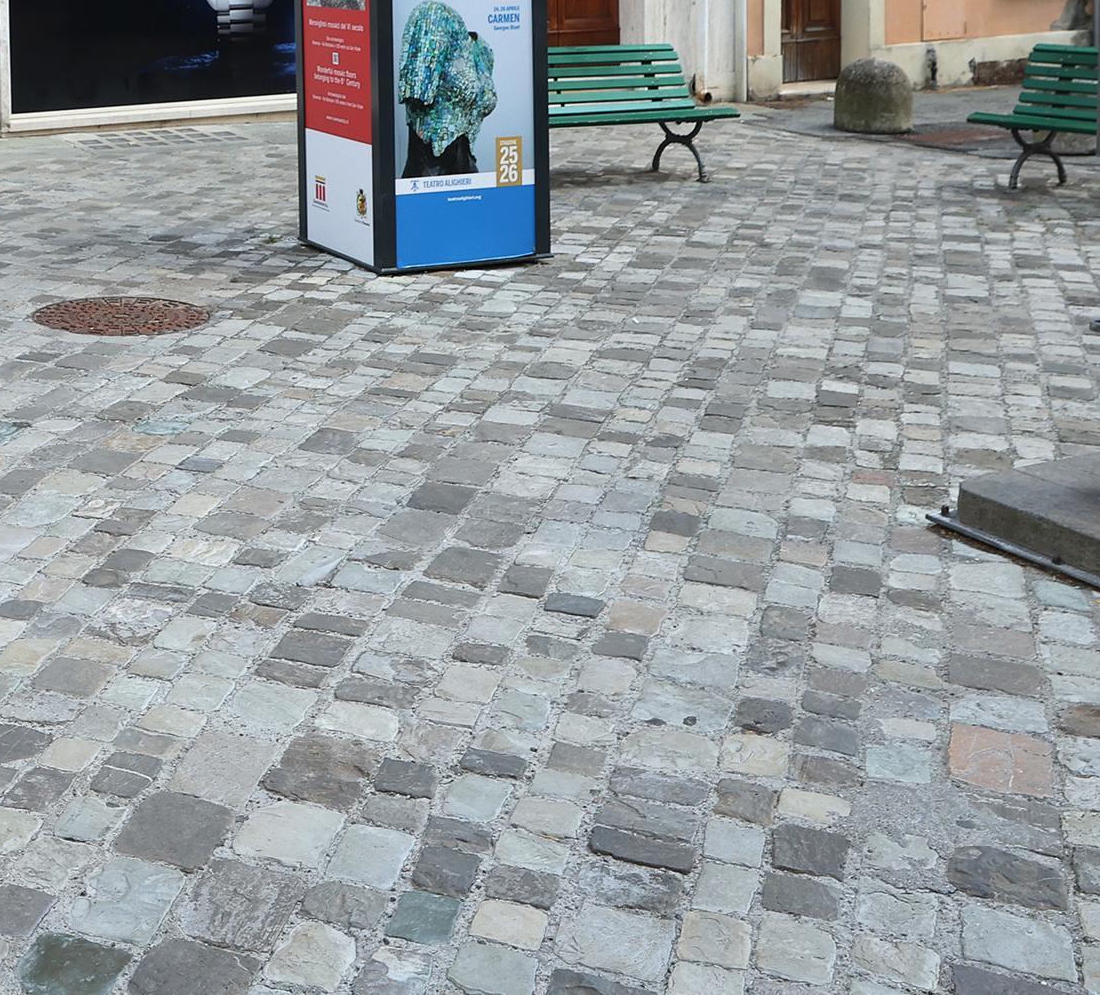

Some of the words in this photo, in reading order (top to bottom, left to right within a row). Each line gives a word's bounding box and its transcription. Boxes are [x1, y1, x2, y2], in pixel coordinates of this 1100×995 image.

[488, 13, 520, 23] CARMEN
[500, 146, 518, 165] 25
[500, 164, 518, 182] 26
[423, 180, 444, 188] TEATRO
[445, 178, 472, 187] ALIGHIERI
